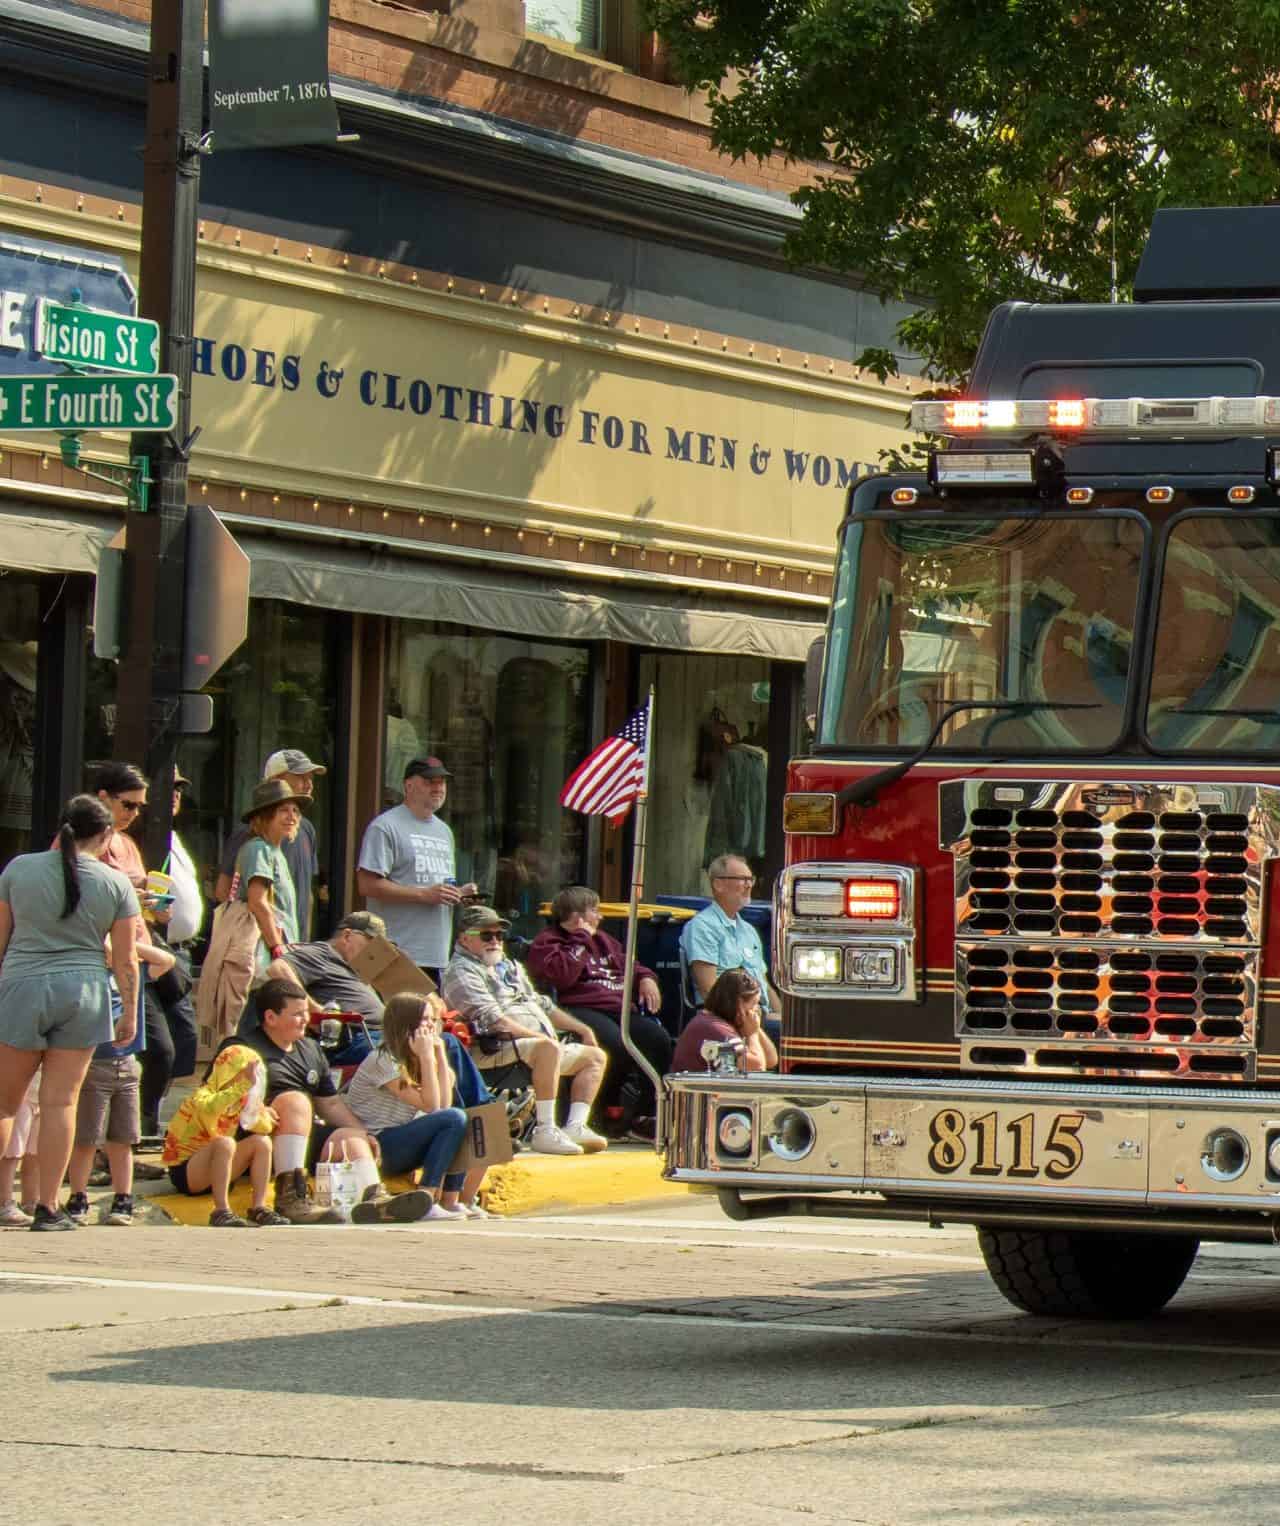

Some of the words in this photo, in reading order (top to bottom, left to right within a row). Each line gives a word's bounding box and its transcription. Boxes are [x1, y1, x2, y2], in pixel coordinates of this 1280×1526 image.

[214, 87, 279, 110] September
[282, 84, 295, 103] 7,
[298, 82, 327, 100] 1876
[46, 313, 106, 361] ision
[115, 324, 139, 366] St
[21, 383, 34, 423] E
[45, 383, 122, 423] Fourth
[134, 383, 160, 423] St
[316, 361, 344, 398] &
[359, 370, 566, 439] CLOTHING
[578, 409, 652, 456] FOR
[664, 426, 738, 471] MEN
[750, 443, 771, 475] &
[928, 1108, 1084, 1180] 8115
